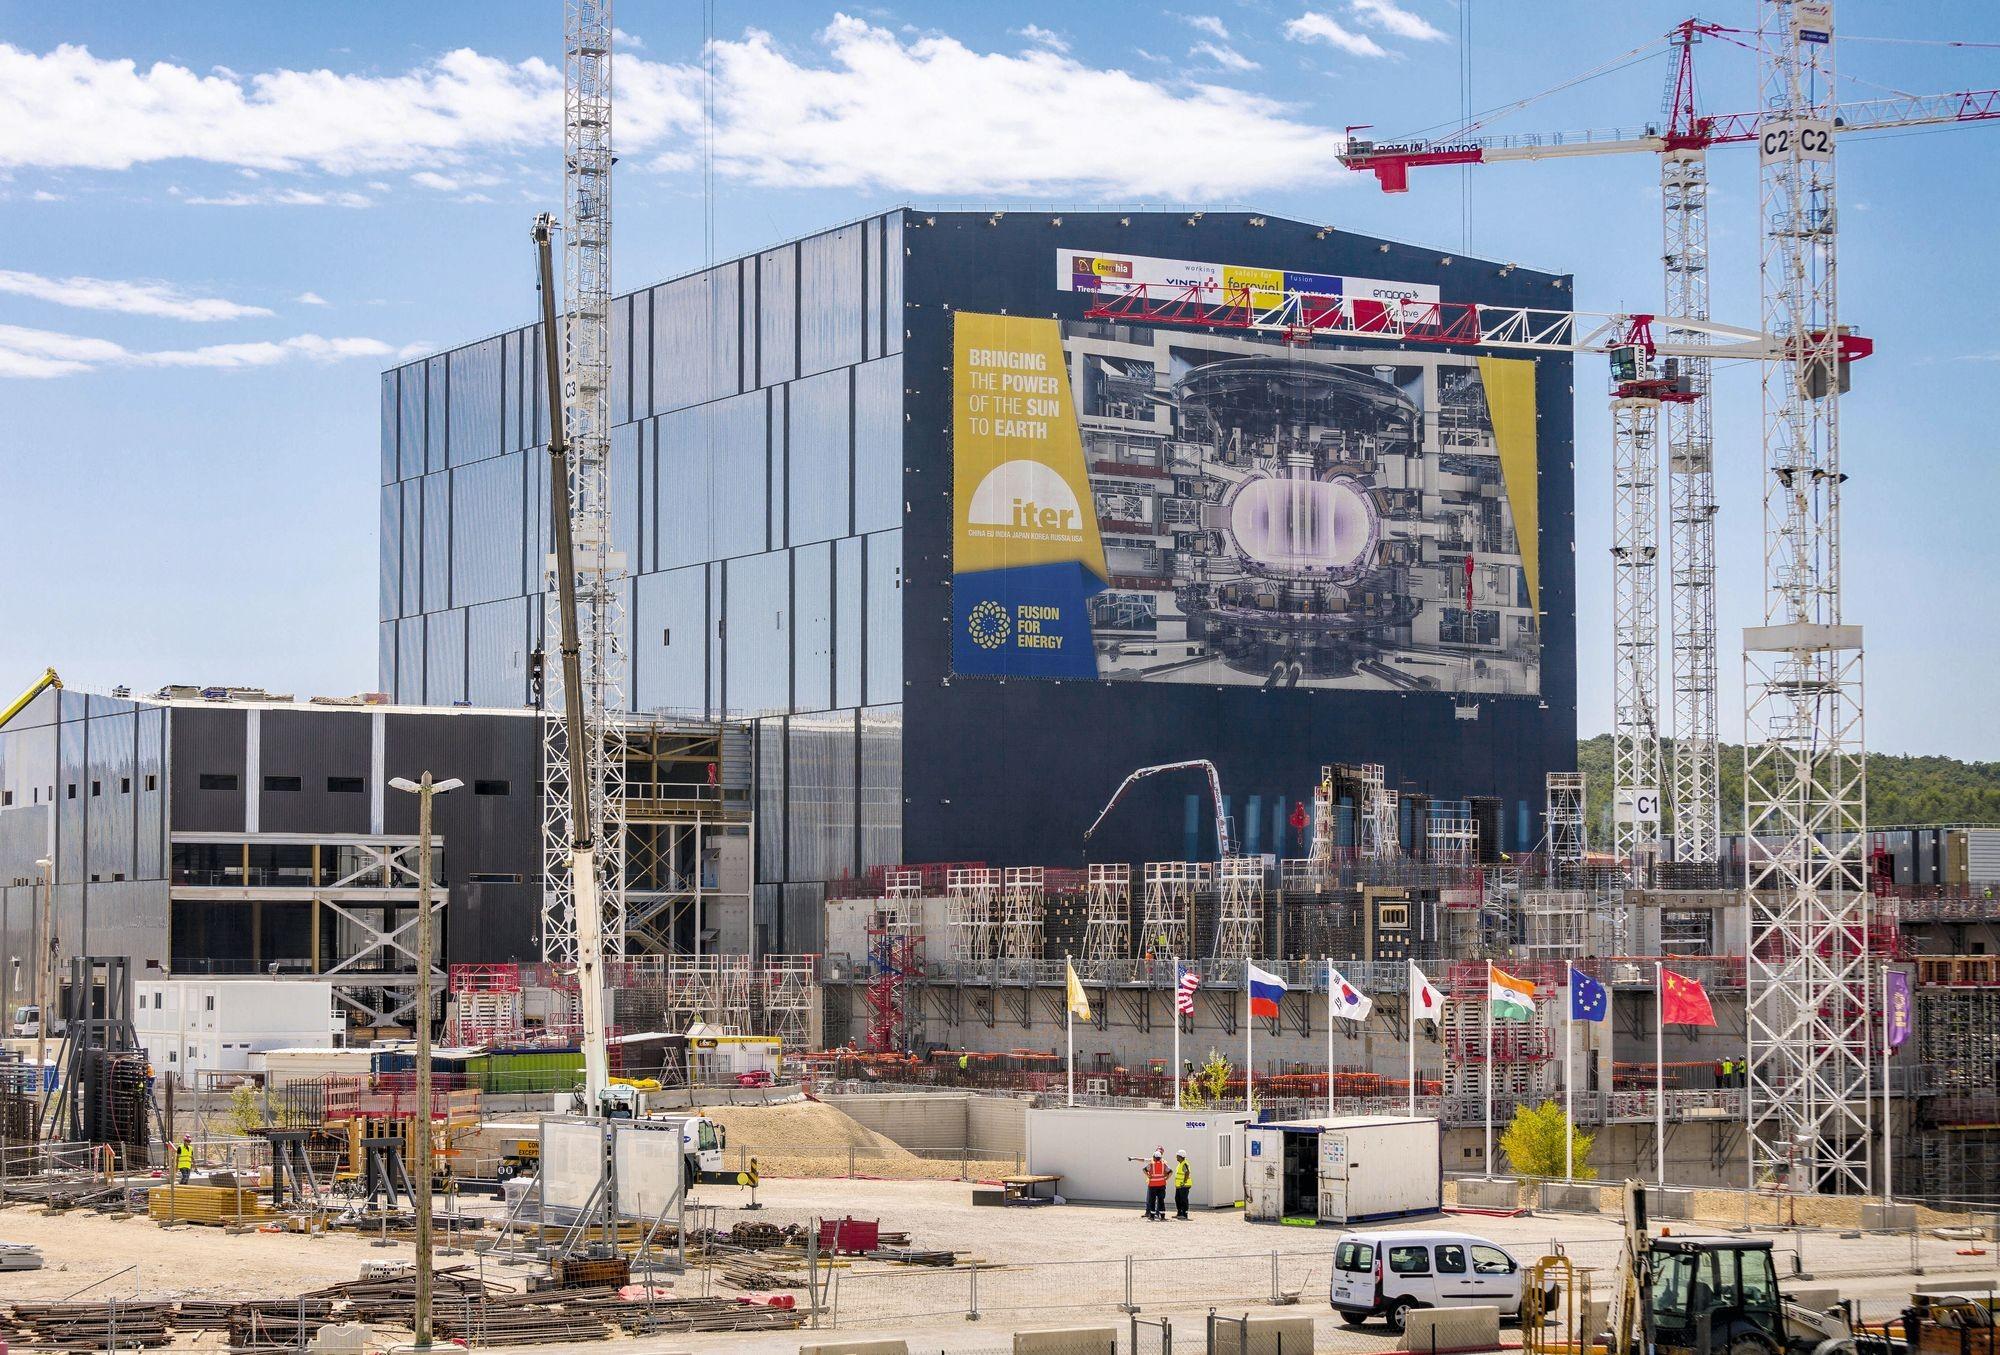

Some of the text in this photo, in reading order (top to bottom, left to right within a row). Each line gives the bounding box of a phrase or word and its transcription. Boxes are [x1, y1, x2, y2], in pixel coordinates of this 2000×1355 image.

[1764, 130, 1788, 155] C2
[1801, 129, 1828, 152] C2
[1097, 263, 1128, 273] Energhia
[1185, 265, 1215, 274] working
[1166, 278, 1201, 287] VINCI
[1290, 275, 1313, 283] fusion
[969, 348, 1047, 371] BRINGING
[565, 381, 576, 398] C3
[969, 372, 1059, 394] THE POWER
[969, 394, 1060, 417] OF THE SUN
[969, 417, 1047, 439] TO EARTH
[1013, 499, 1074, 528] iter
[968, 529, 986, 537] CHINA
[1018, 605, 1059, 620] FUSION
[1018, 620, 1041, 634] FOR
[1018, 635, 1063, 649] ENERGY
[1637, 796, 1659, 814] C1
